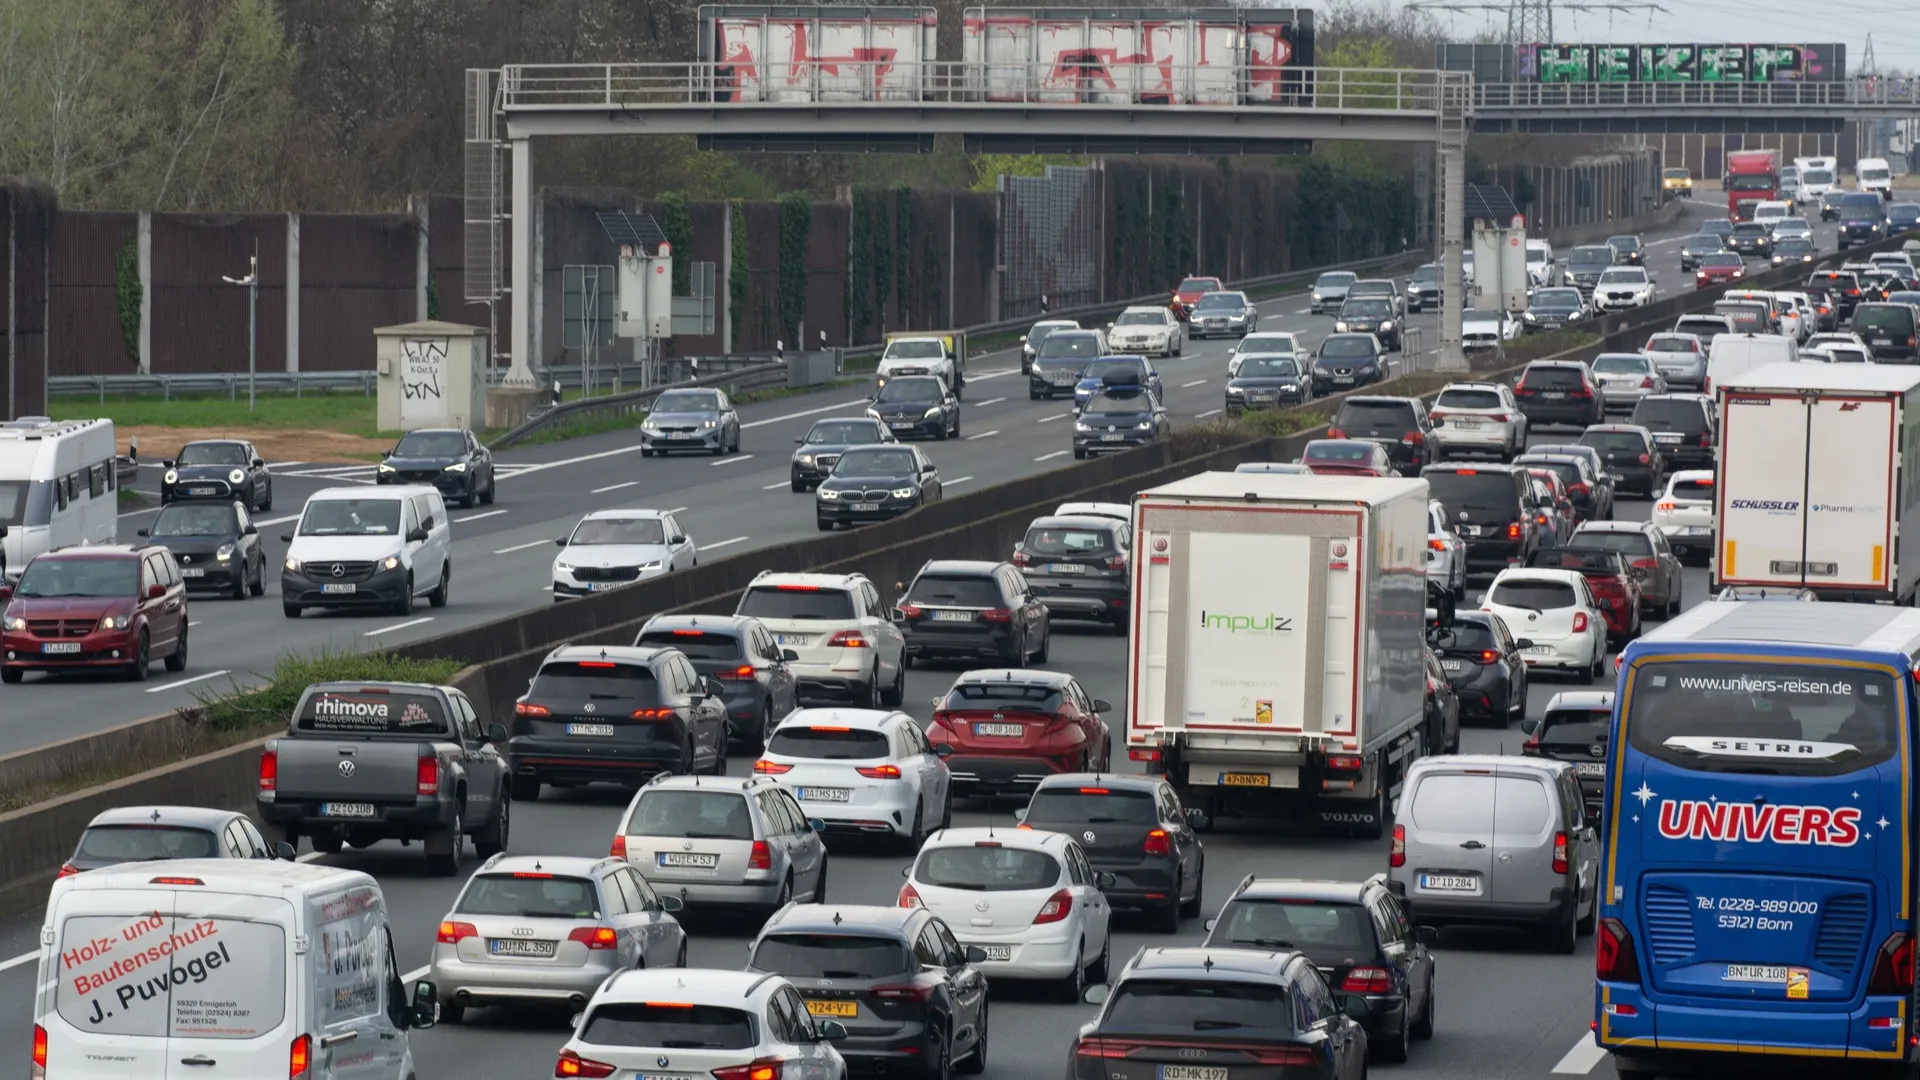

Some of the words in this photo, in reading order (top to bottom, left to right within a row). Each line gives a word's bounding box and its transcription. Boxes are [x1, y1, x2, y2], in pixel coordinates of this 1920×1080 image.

[1679, 676, 1852, 695] www.univers-reisen.de
[315, 696, 388, 716] rhimova
[315, 715, 388, 724] HAUSVERWALTUNG
[1711, 741, 1813, 754] SETRA
[1320, 812, 1374, 823] VOLVO
[1658, 799, 1862, 847] UNIVERS
[1696, 896, 1715, 910] Tel.
[1718, 915, 1754, 929] 53121
[1756, 917, 1794, 931] Bonn
[62, 937, 118, 969] Holz-
[121, 910, 164, 942] und
[532, 942, 552, 953] 350
[73, 919, 219, 996] Bautenschutz
[1728, 966, 1743, 977] BN
[1749, 967, 1763, 978] UR
[1766, 968, 1786, 979] 108
[89, 998, 113, 1024] J.
[116, 940, 231, 1010] Puvogel
[86, 1054, 137, 1062] TRANSIT
[1164, 1067, 1179, 1078] RD
[1186, 1068, 1202, 1079] MK
[1204, 1069, 1227, 1080] 197
